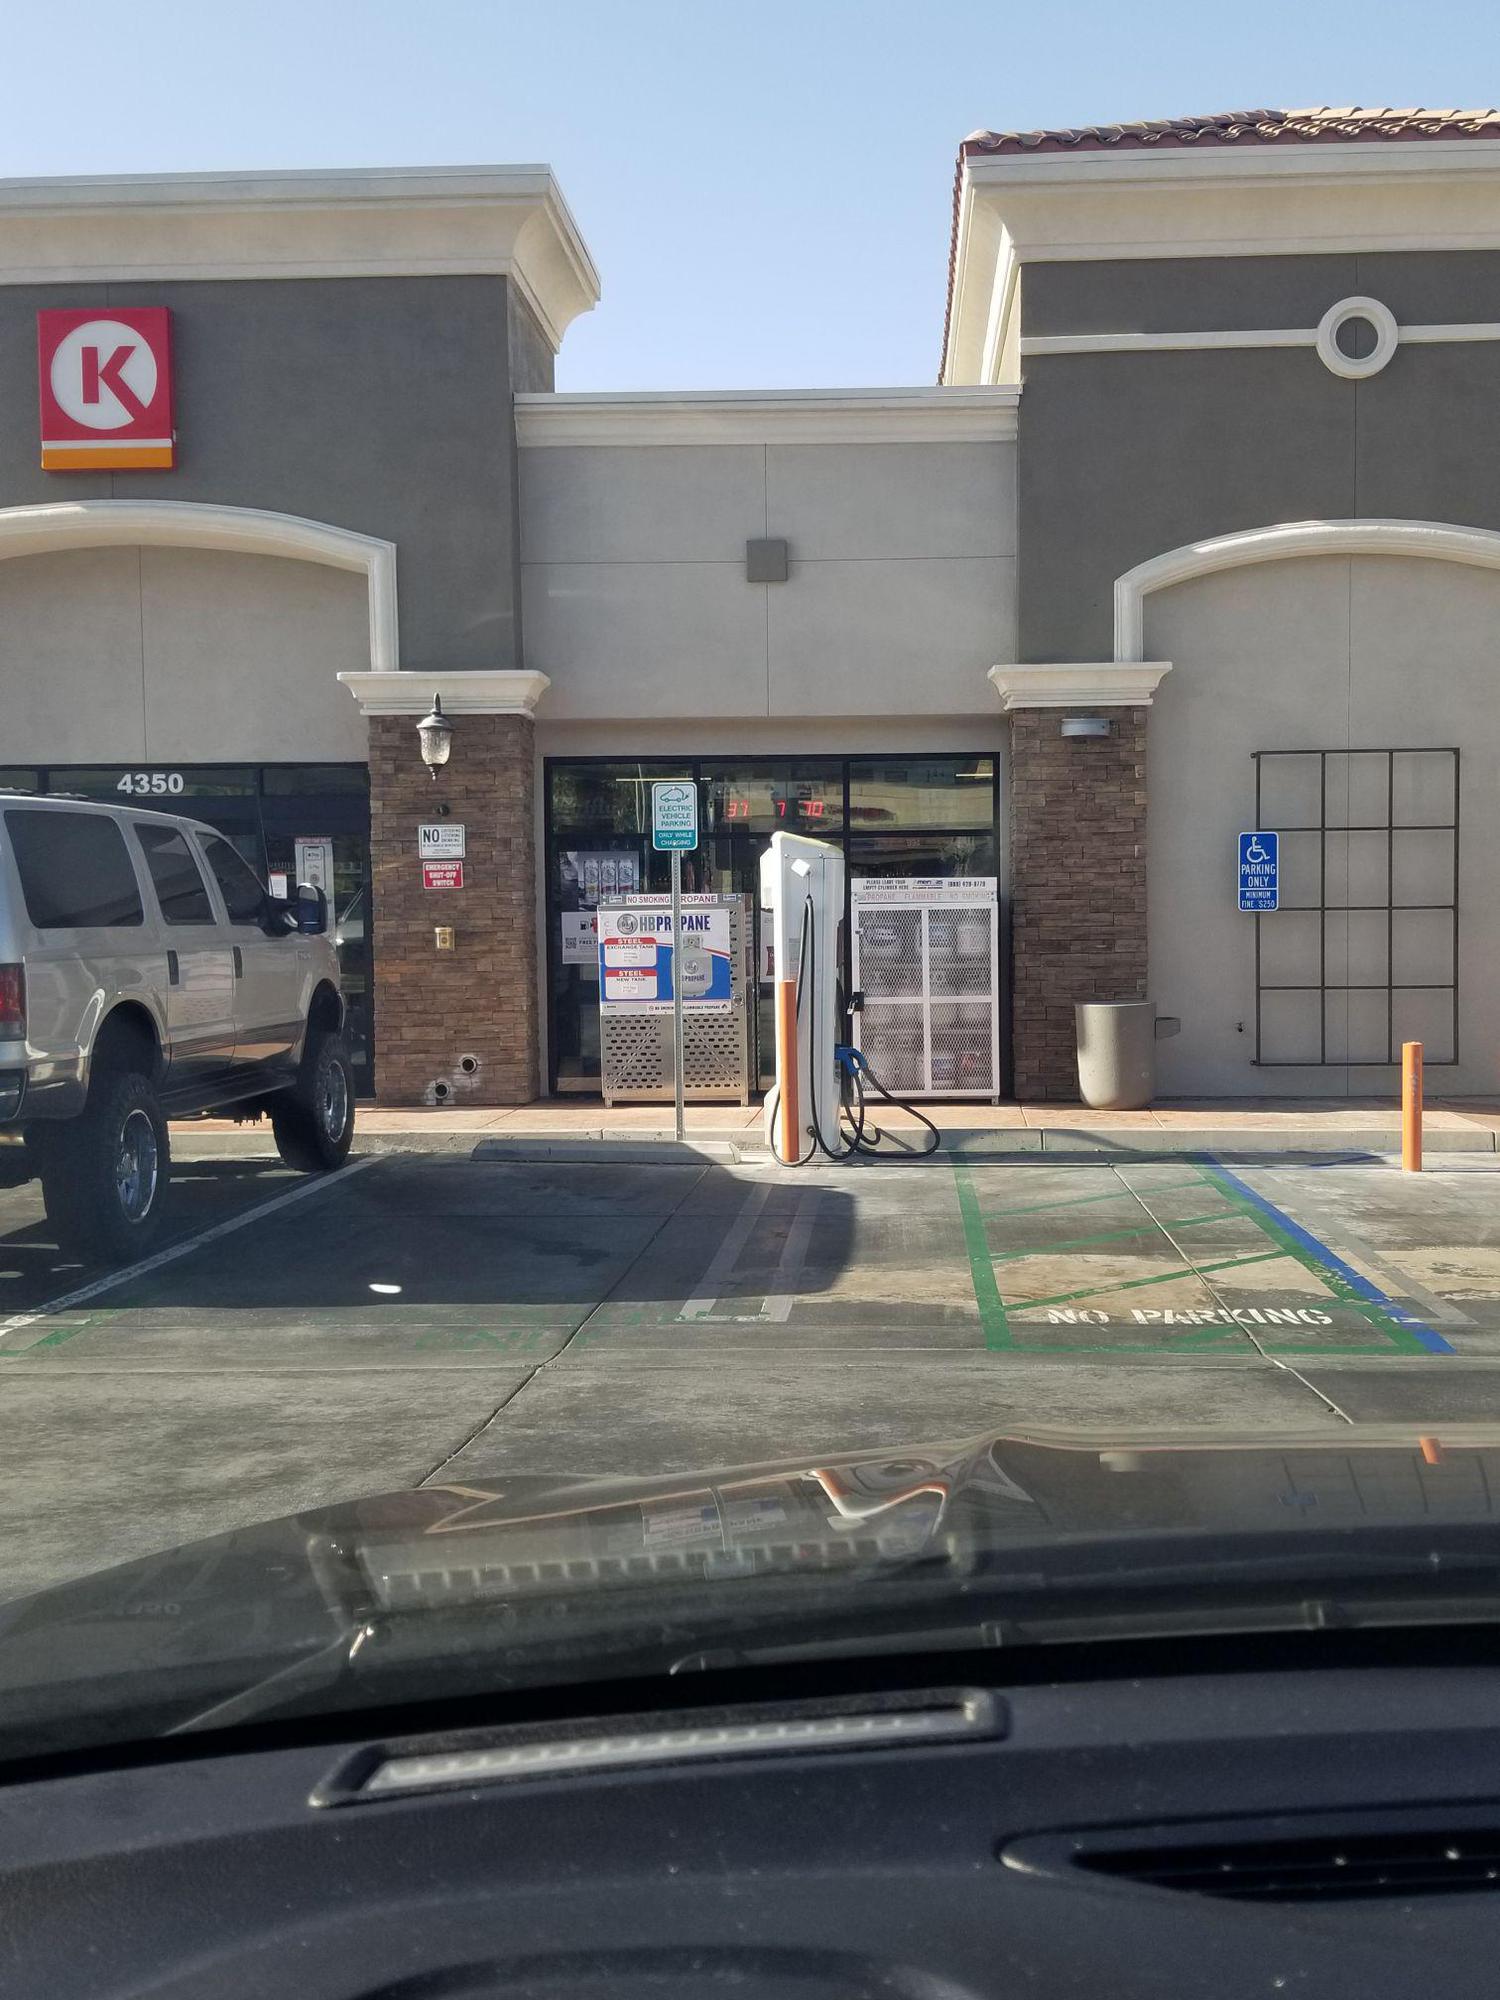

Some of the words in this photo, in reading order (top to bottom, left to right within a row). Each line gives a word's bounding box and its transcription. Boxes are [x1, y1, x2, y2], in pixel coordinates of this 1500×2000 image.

[82, 346, 148, 421] K
[117, 773, 184, 794] 4350
[659, 804, 693, 812] ELECTRIC
[423, 829, 440, 843] NO
[429, 871, 457, 879] SHUT-OFF
[1241, 864, 1276, 875] PARKING
[432, 879, 455, 887] SWITCH
[1248, 876, 1269, 888] ONLY
[627, 896, 640, 905] NO
[640, 895, 670, 904] SMOKING
[680, 895, 717, 904] ROPANE
[1245, 891, 1271, 899] MINIMUM
[1241, 900, 1254, 909] FINE
[1258, 900, 1275, 909] $250
[639, 915, 711, 932] HBPRPANE
[1048, 1309, 1110, 1325] NO
[1131, 1308, 1333, 1325] PARKING
